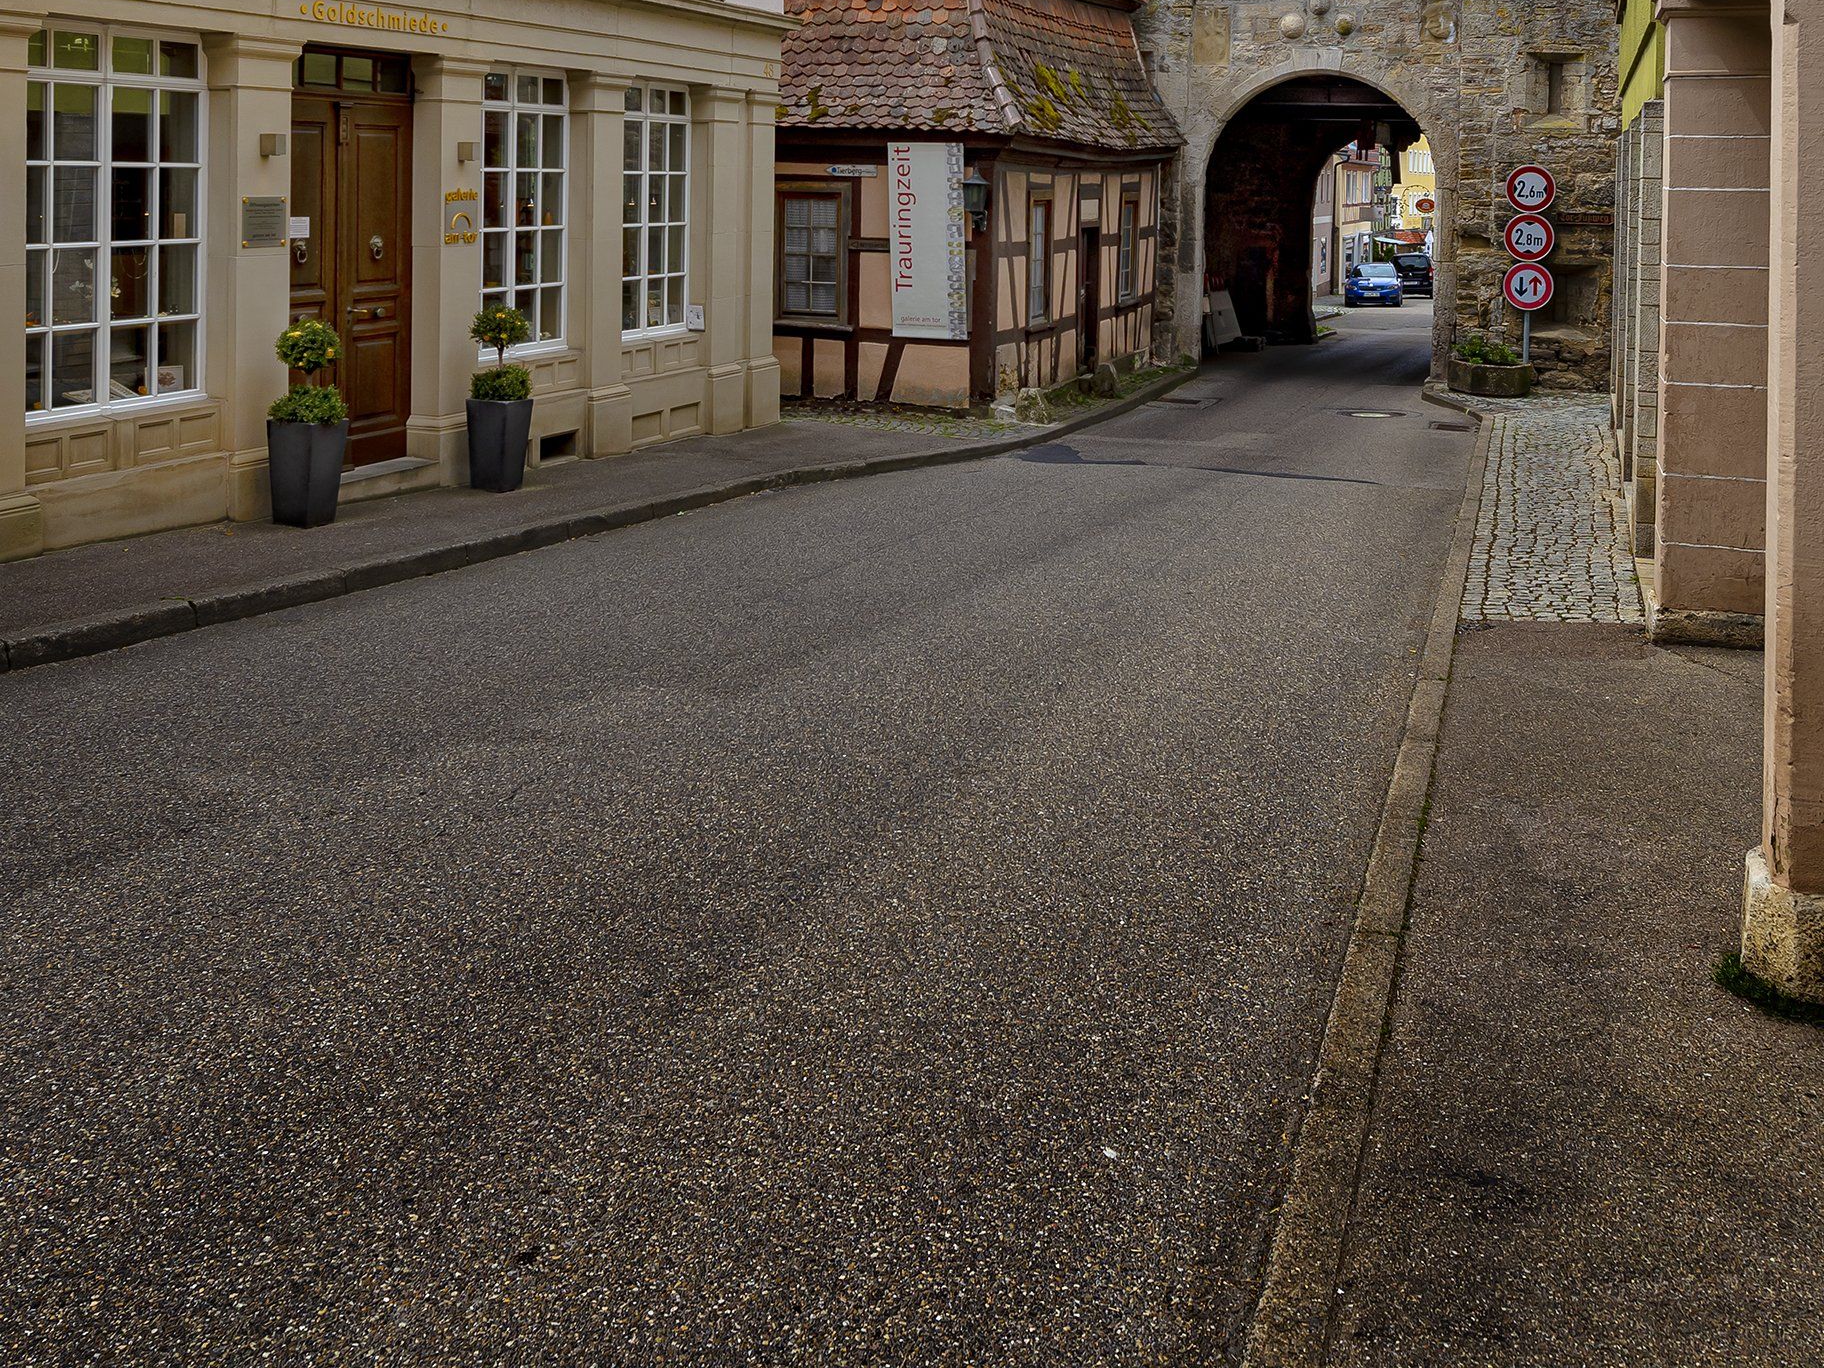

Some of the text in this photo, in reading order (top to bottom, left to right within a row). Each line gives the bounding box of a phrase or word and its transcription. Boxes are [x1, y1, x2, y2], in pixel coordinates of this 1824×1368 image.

[312, 0, 438, 34] Goldschmiede
[445, 188, 479, 205] galerie
[1516, 180, 1544, 199] 2,6m
[891, 144, 916, 293] Trauringzeit
[1514, 228, 1543, 247] 2,8m
